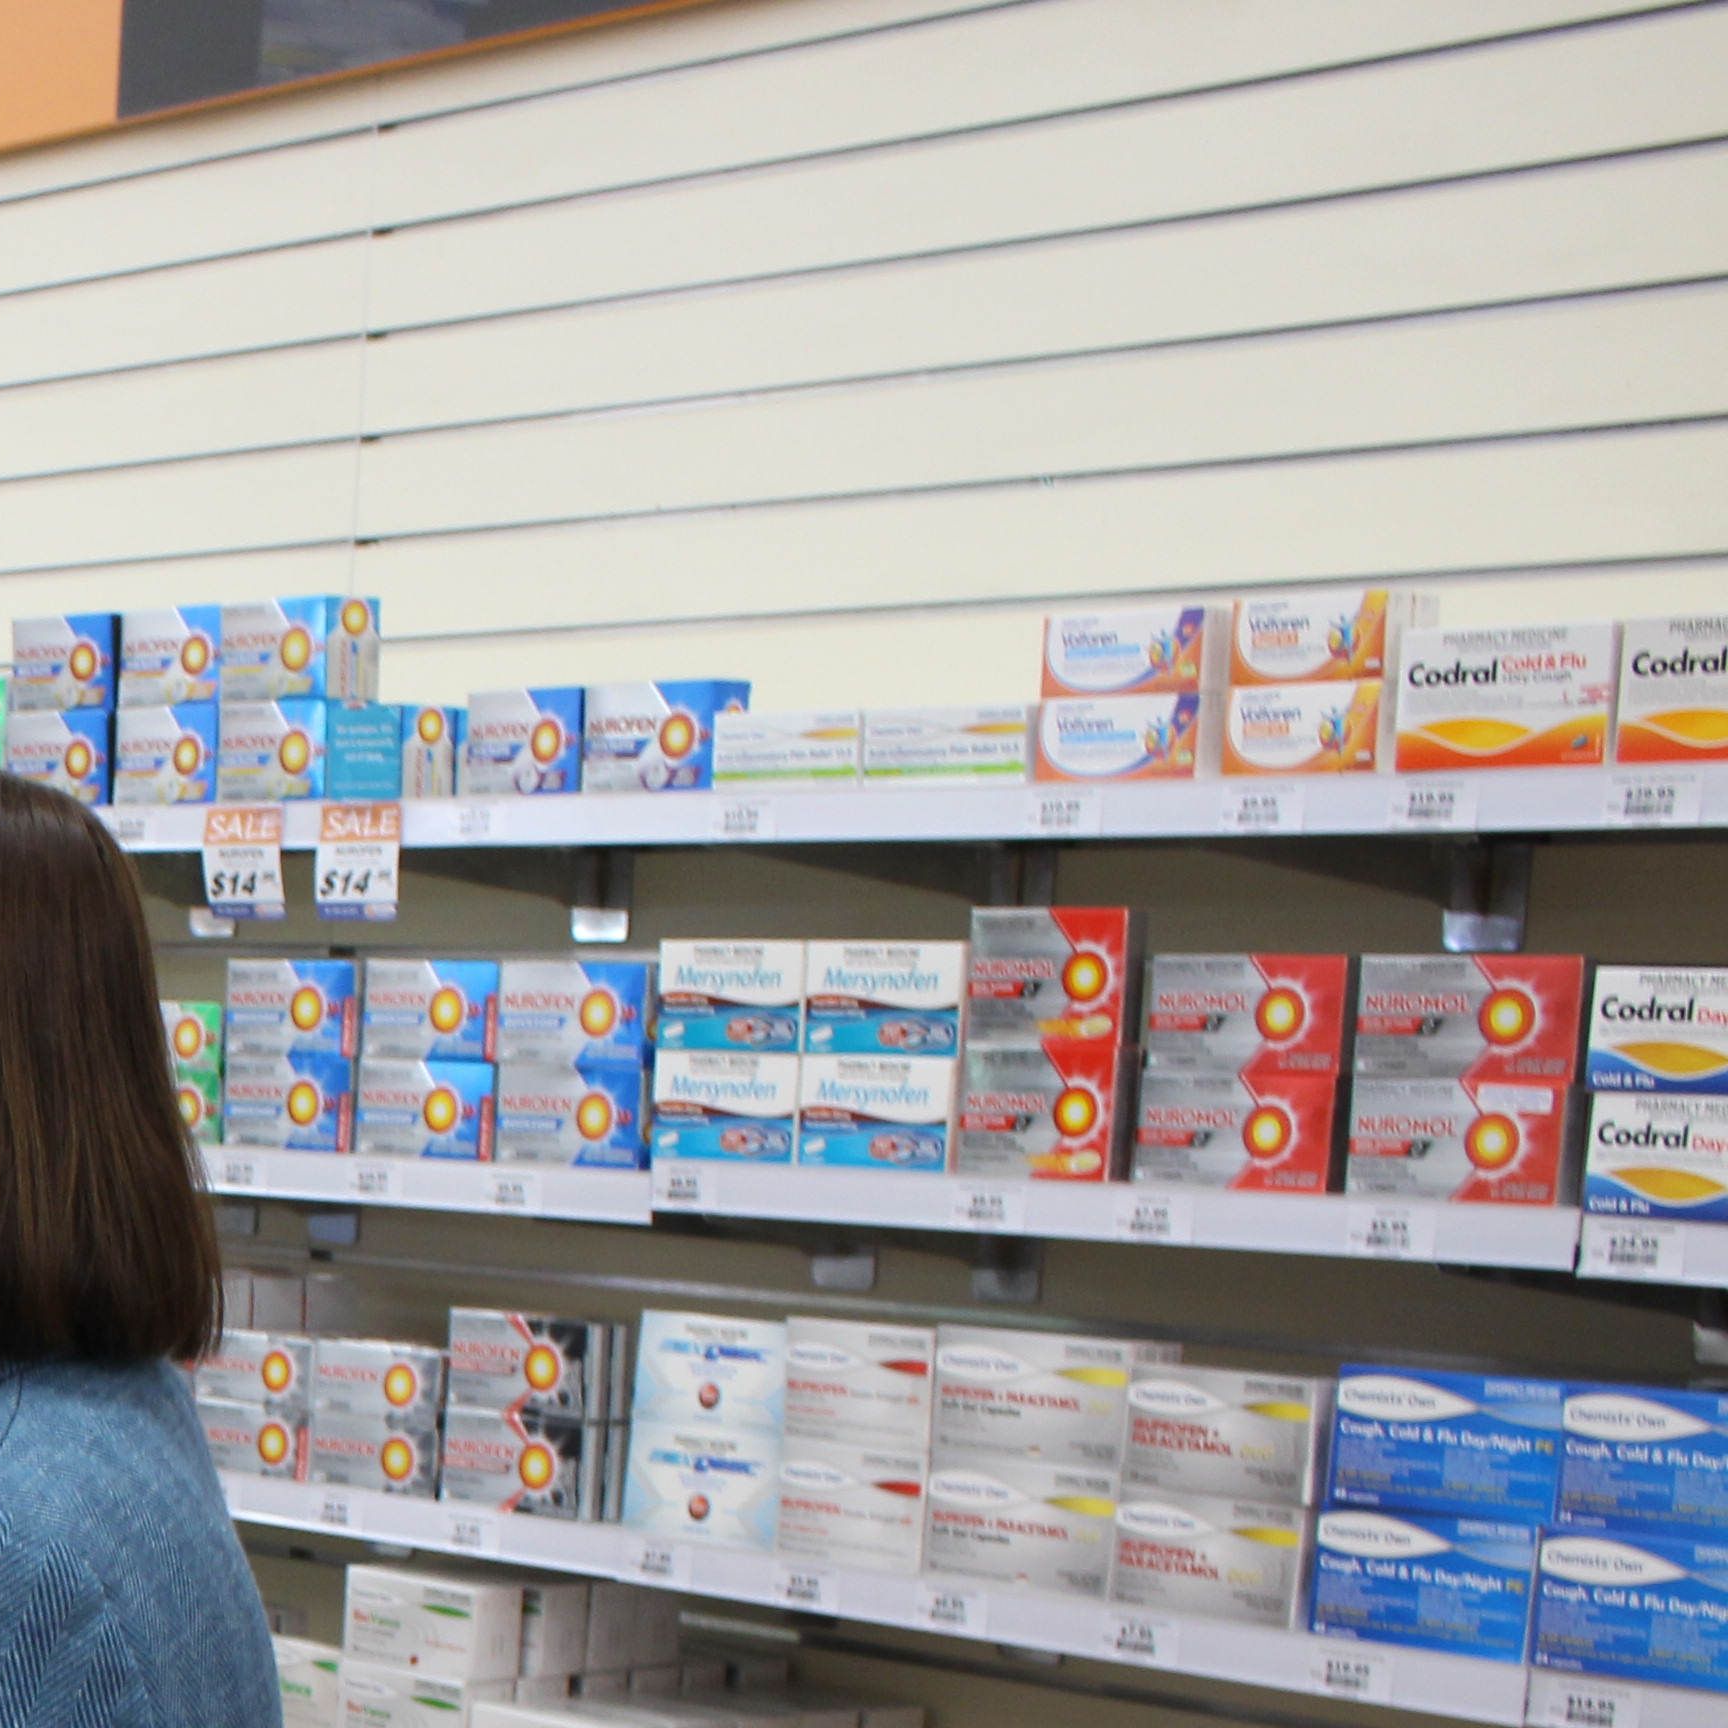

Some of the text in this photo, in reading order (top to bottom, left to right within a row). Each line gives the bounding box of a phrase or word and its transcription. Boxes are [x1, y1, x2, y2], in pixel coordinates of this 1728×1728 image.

[1249, 616, 1310, 633] Voltaren
[1062, 632, 1118, 649] Voltaren
[1502, 652, 1588, 671] Cold & Flu
[1408, 658, 1498, 688] Codral
[471, 724, 529, 738] NUROFEN
[589, 719, 656, 734] NUROFEN
[1057, 717, 1114, 732] Voltaren
[207, 814, 278, 840] SALE
[323, 811, 395, 837] SALE
[974, 959, 1055, 979] NUROMOL
[676, 965, 782, 994] Mersynofen
[824, 966, 940, 993] Mersynofen
[1640, 972, 1700, 987] PHARMACY
[1159, 993, 1250, 1012] NUROMOL
[1365, 993, 1473, 1013] NUROMOL
[1601, 996, 1694, 1022] Codral
[671, 1074, 777, 1102] Mersynofen
[816, 1080, 929, 1107] Mersynofen
[967, 1094, 1048, 1112] NUROMOL
[1146, 1108, 1237, 1128] NUROMOL
[1357, 1116, 1457, 1138] NUROMOL
[455, 1341, 521, 1361] NUROFEN
[319, 1364, 378, 1383] NUROFEN
[1408, 1395, 1436, 1408] Own
[1134, 1418, 1207, 1436] IBUPROFEN
[1636, 1414, 1665, 1429] Own
[315, 1437, 376, 1456] NUROFEN
[1132, 1432, 1233, 1458] PARACETAMOL
[1390, 1423, 1419, 1442] Cold
[1423, 1427, 1434, 1443] &
[1437, 1429, 1457, 1446] Flu
[1461, 1431, 1532, 1453] Day/Night
[448, 1440, 515, 1459] NUROFEN
[1617, 1444, 1647, 1464] Cold
[1652, 1449, 1664, 1465] &
[1667, 1449, 1689, 1467] Flu
[1367, 1560, 1394, 1579] Cold
[1399, 1565, 1409, 1580] &
[1412, 1566, 1431, 1584] Flu
[1436, 1569, 1502, 1592] Day/Night
[1613, 1560, 1642, 1574] Own
[1593, 1588, 1625, 1607] Cold
[1630, 1594, 1641, 1609] &
[1645, 1595, 1665, 1612] Flu
[1669, 1598, 1728, 1621] Day/Nig
